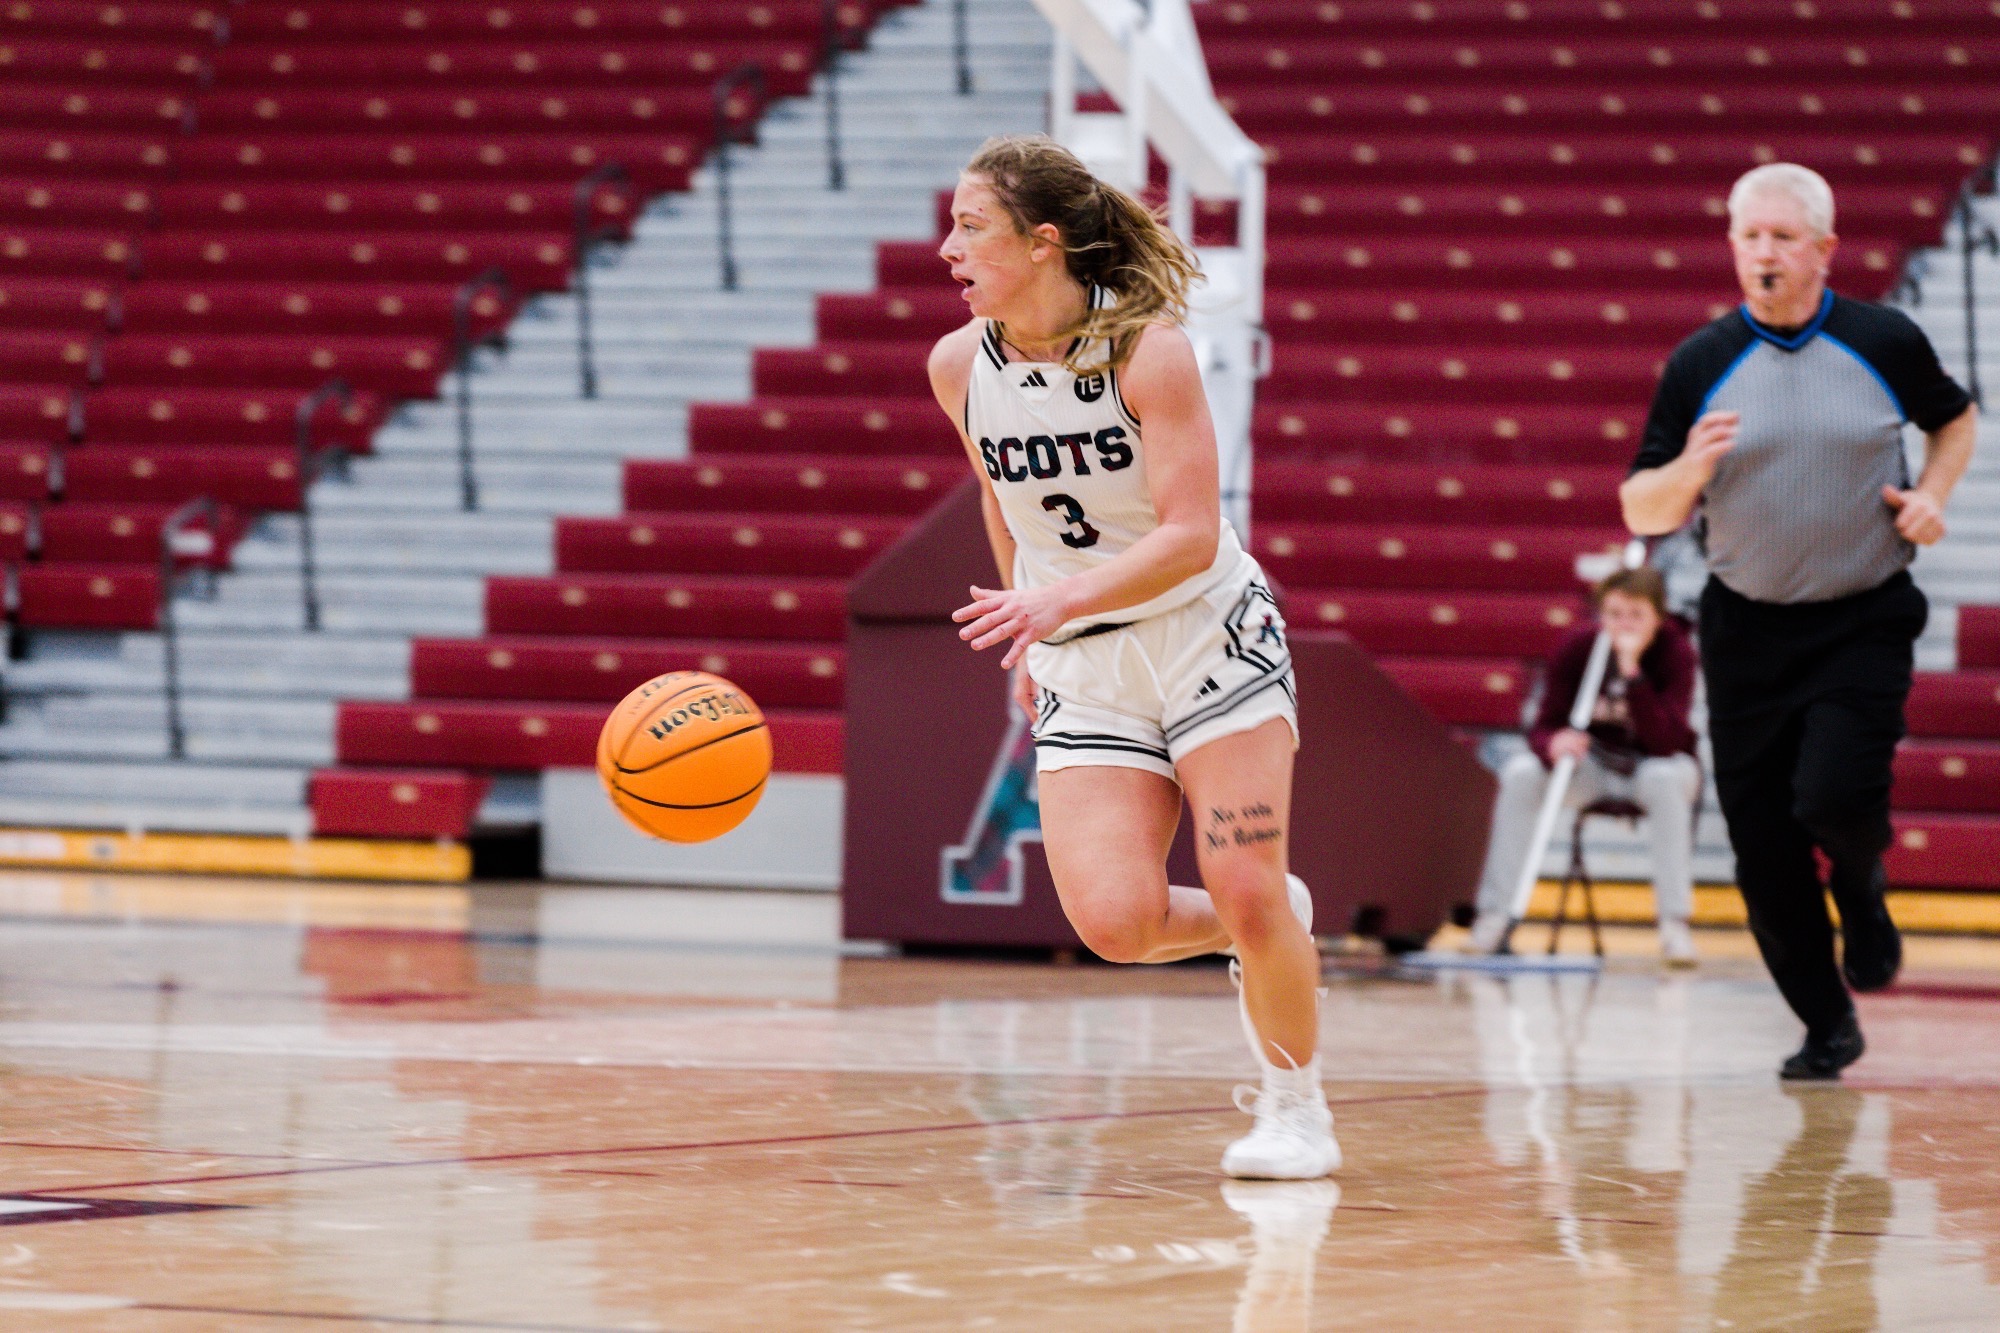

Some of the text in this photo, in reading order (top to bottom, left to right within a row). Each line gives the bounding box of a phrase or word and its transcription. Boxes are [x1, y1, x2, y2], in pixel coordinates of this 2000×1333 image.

[1077, 375, 1103, 396] TE
[979, 425, 1134, 482] SCOTS
[1041, 493, 1100, 549] 3
